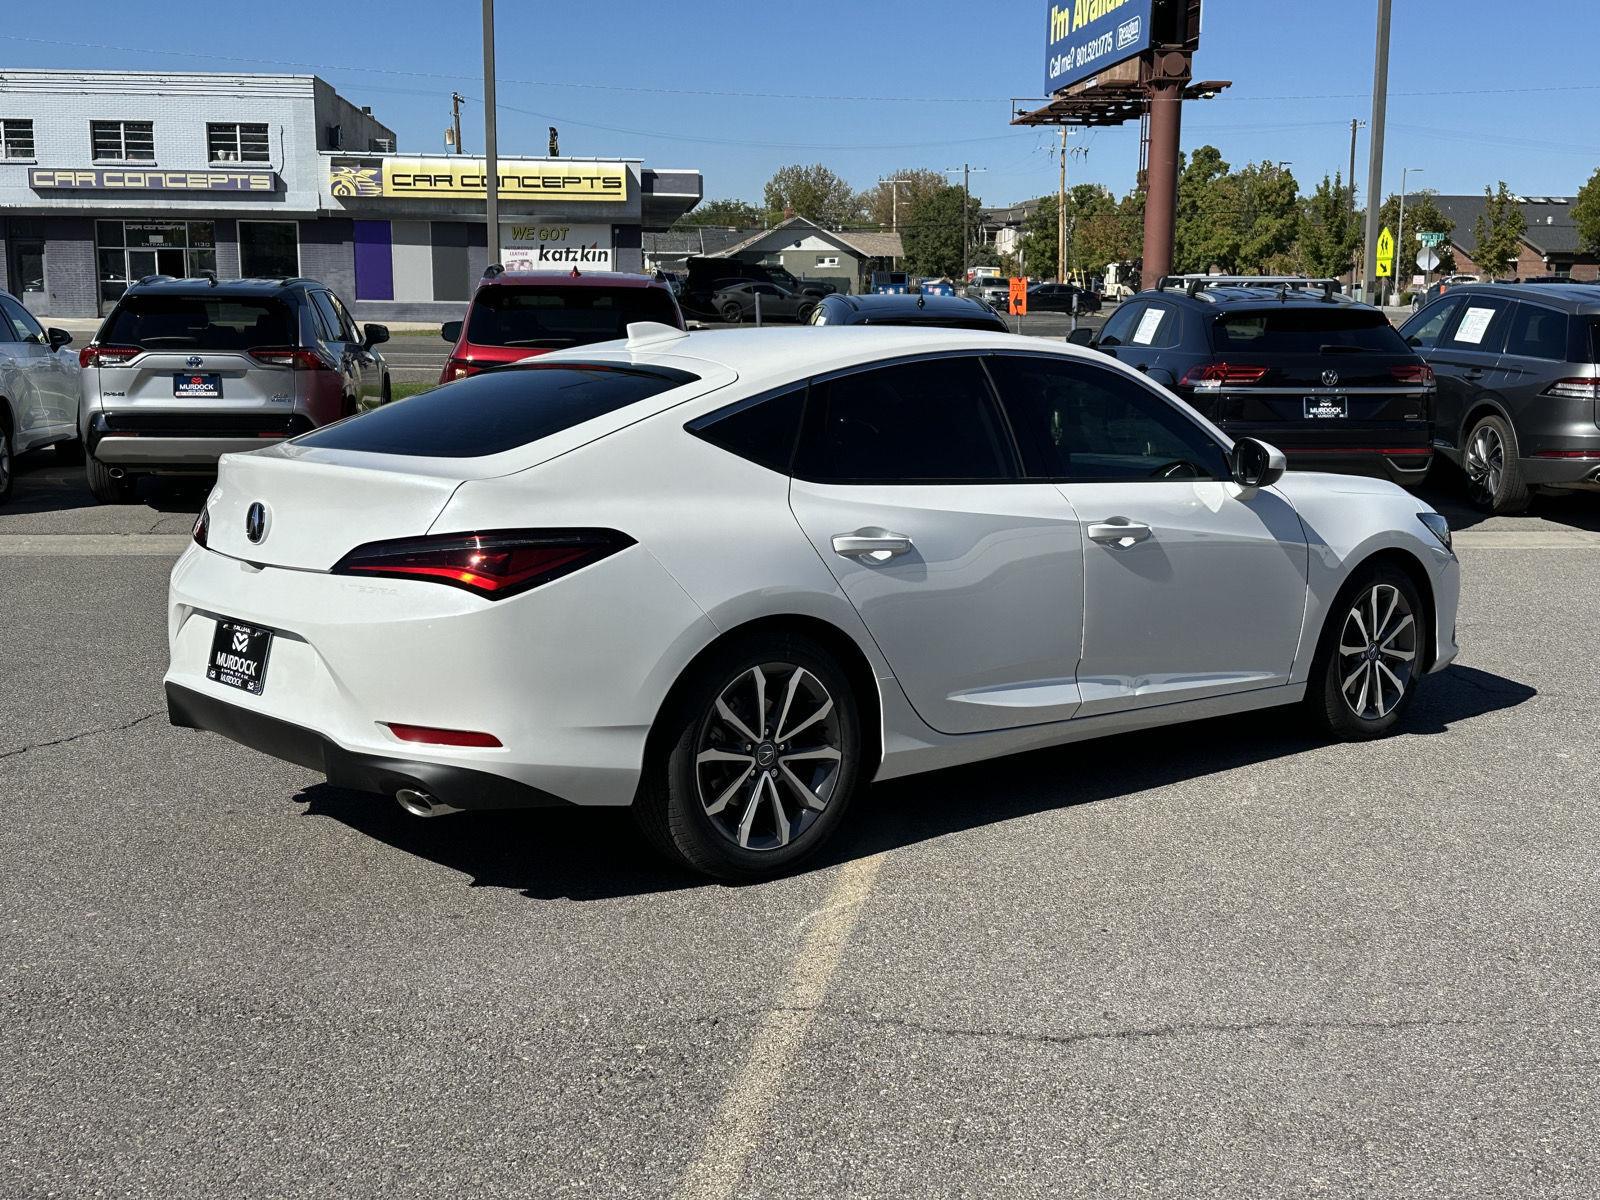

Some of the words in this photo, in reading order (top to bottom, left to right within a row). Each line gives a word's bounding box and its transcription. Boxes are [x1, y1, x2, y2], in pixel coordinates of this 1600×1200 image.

[1050, 5, 1069, 45] I'm
[1072, 0, 1129, 32] Availa
[1050, 55, 1061, 79] Call
[1061, 46, 1075, 73] me?
[1076, 31, 1113, 67] 801.521.1775
[33, 171, 96, 187] CAR
[103, 172, 271, 189] CONCEPTS
[392, 174, 453, 187] CAR
[512, 226, 535, 241] WE
[538, 226, 570, 241] GOT
[538, 244, 609, 262] katzkin
[215, 651, 258, 677] MURDOCK
[220, 673, 243, 687] MURDOCK
